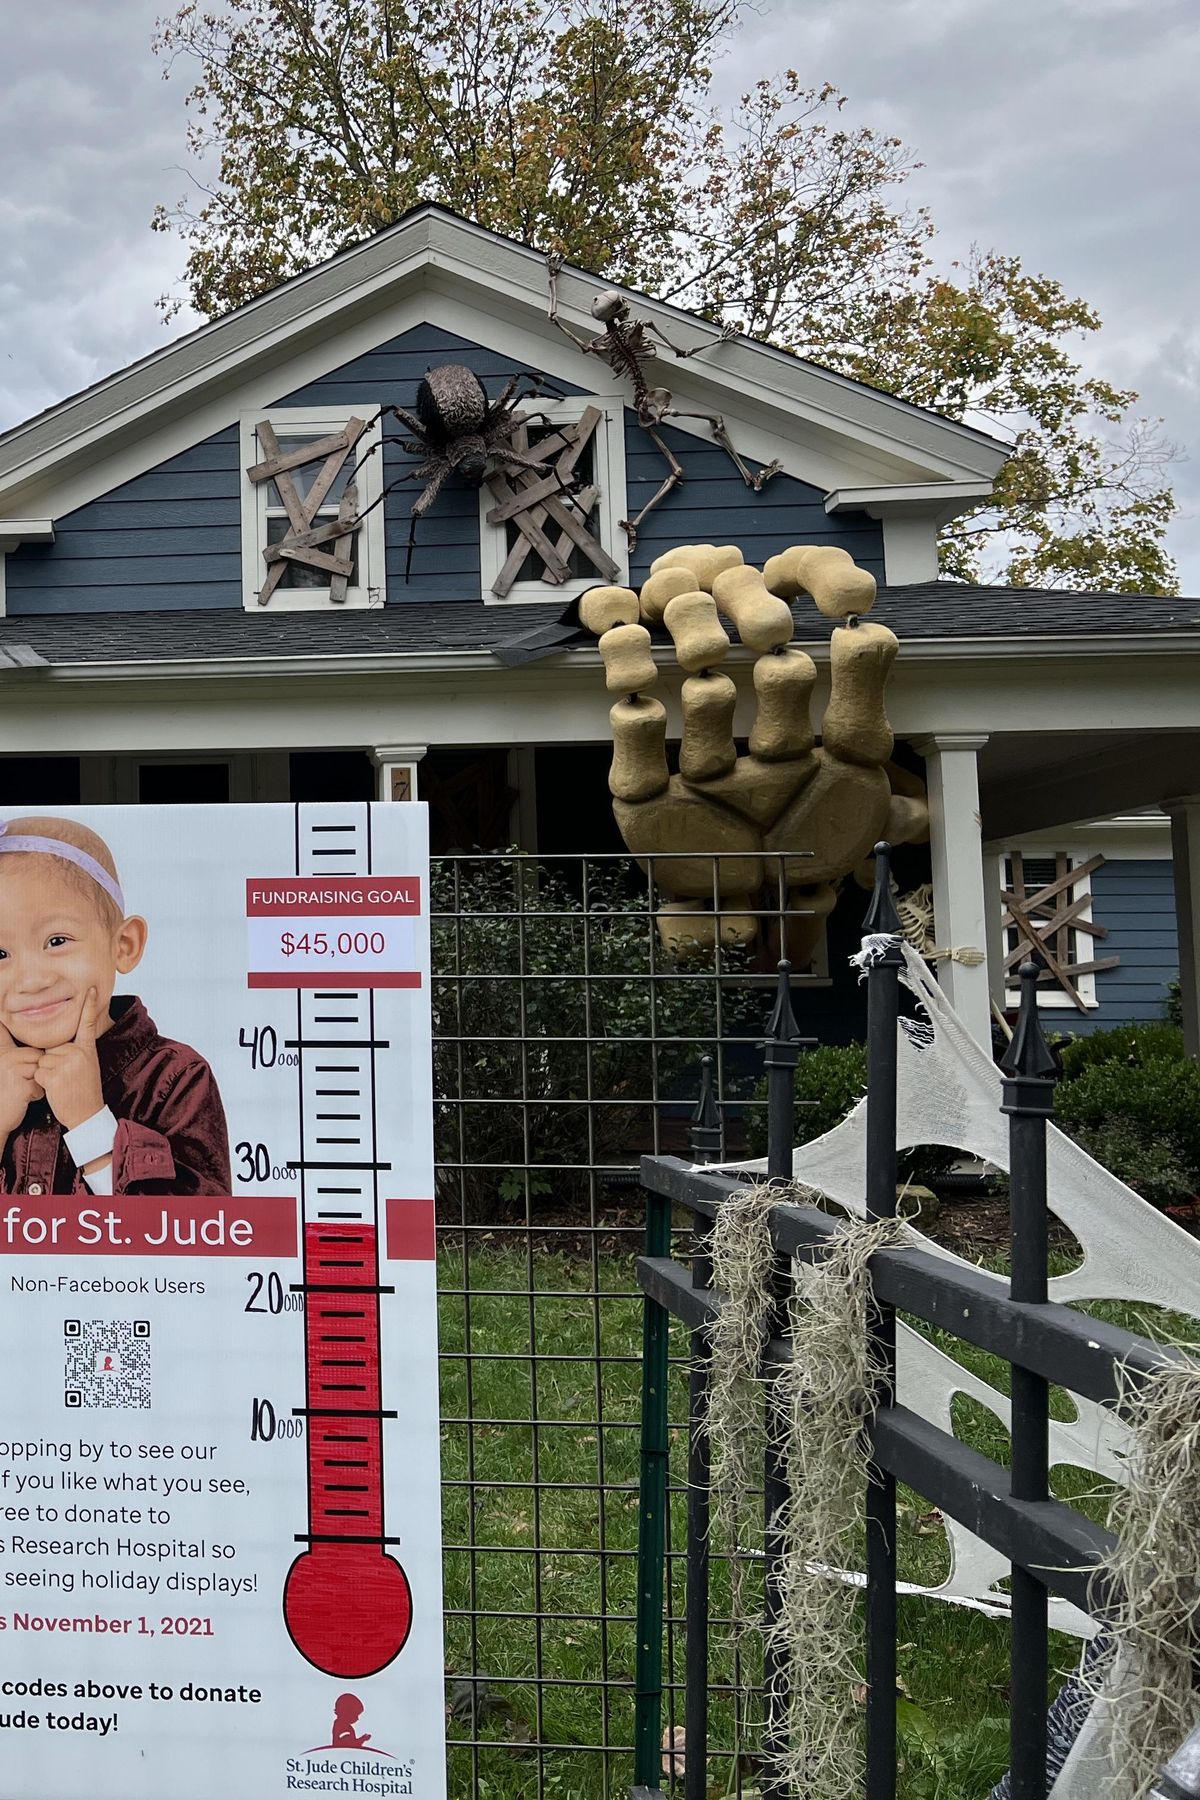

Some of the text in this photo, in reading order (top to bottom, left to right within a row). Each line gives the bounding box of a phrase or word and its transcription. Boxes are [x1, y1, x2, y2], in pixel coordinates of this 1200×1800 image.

[252, 890, 415, 905] FUNDRAISING GOAL
[280, 931, 385, 958] $45,000
[2, 1206, 67, 1244] for
[77, 1209, 132, 1245] St.
[143, 1209, 253, 1246] Jude
[11, 1275, 206, 1294] Non-Facebook Users
[79, 1438, 104, 1463] by
[109, 1440, 132, 1459] to
[138, 1444, 175, 1459] see
[180, 1445, 218, 1460] our
[15, 1474, 54, 1494] you
[61, 1471, 97, 1491] like
[103, 1472, 158, 1492] what
[162, 1477, 202, 1497] you
[208, 1478, 250, 1497] see,
[35, 1504, 59, 1522] to
[64, 1503, 142, 1524] donate
[147, 1506, 171, 1525] to
[12, 1535, 109, 1556] Research
[117, 1537, 205, 1562] Hospital
[211, 1544, 236, 1559] so
[5, 1568, 75, 1593] seeing
[82, 1569, 161, 1595] holiday
[166, 1571, 258, 1597] displays!
[13, 1612, 133, 1634] November
[137, 1616, 155, 1638] 1,
[160, 1616, 215, 1636] 2021
[1, 1677, 68, 1698] codes
[73, 1679, 143, 1700] above
[148, 1682, 174, 1701] to
[179, 1682, 262, 1704] donate
[45, 1711, 118, 1737] today!
[286, 1758, 304, 1773] St.
[306, 1759, 338, 1776] Jude
[286, 1775, 413, 1798] Research Hospital
